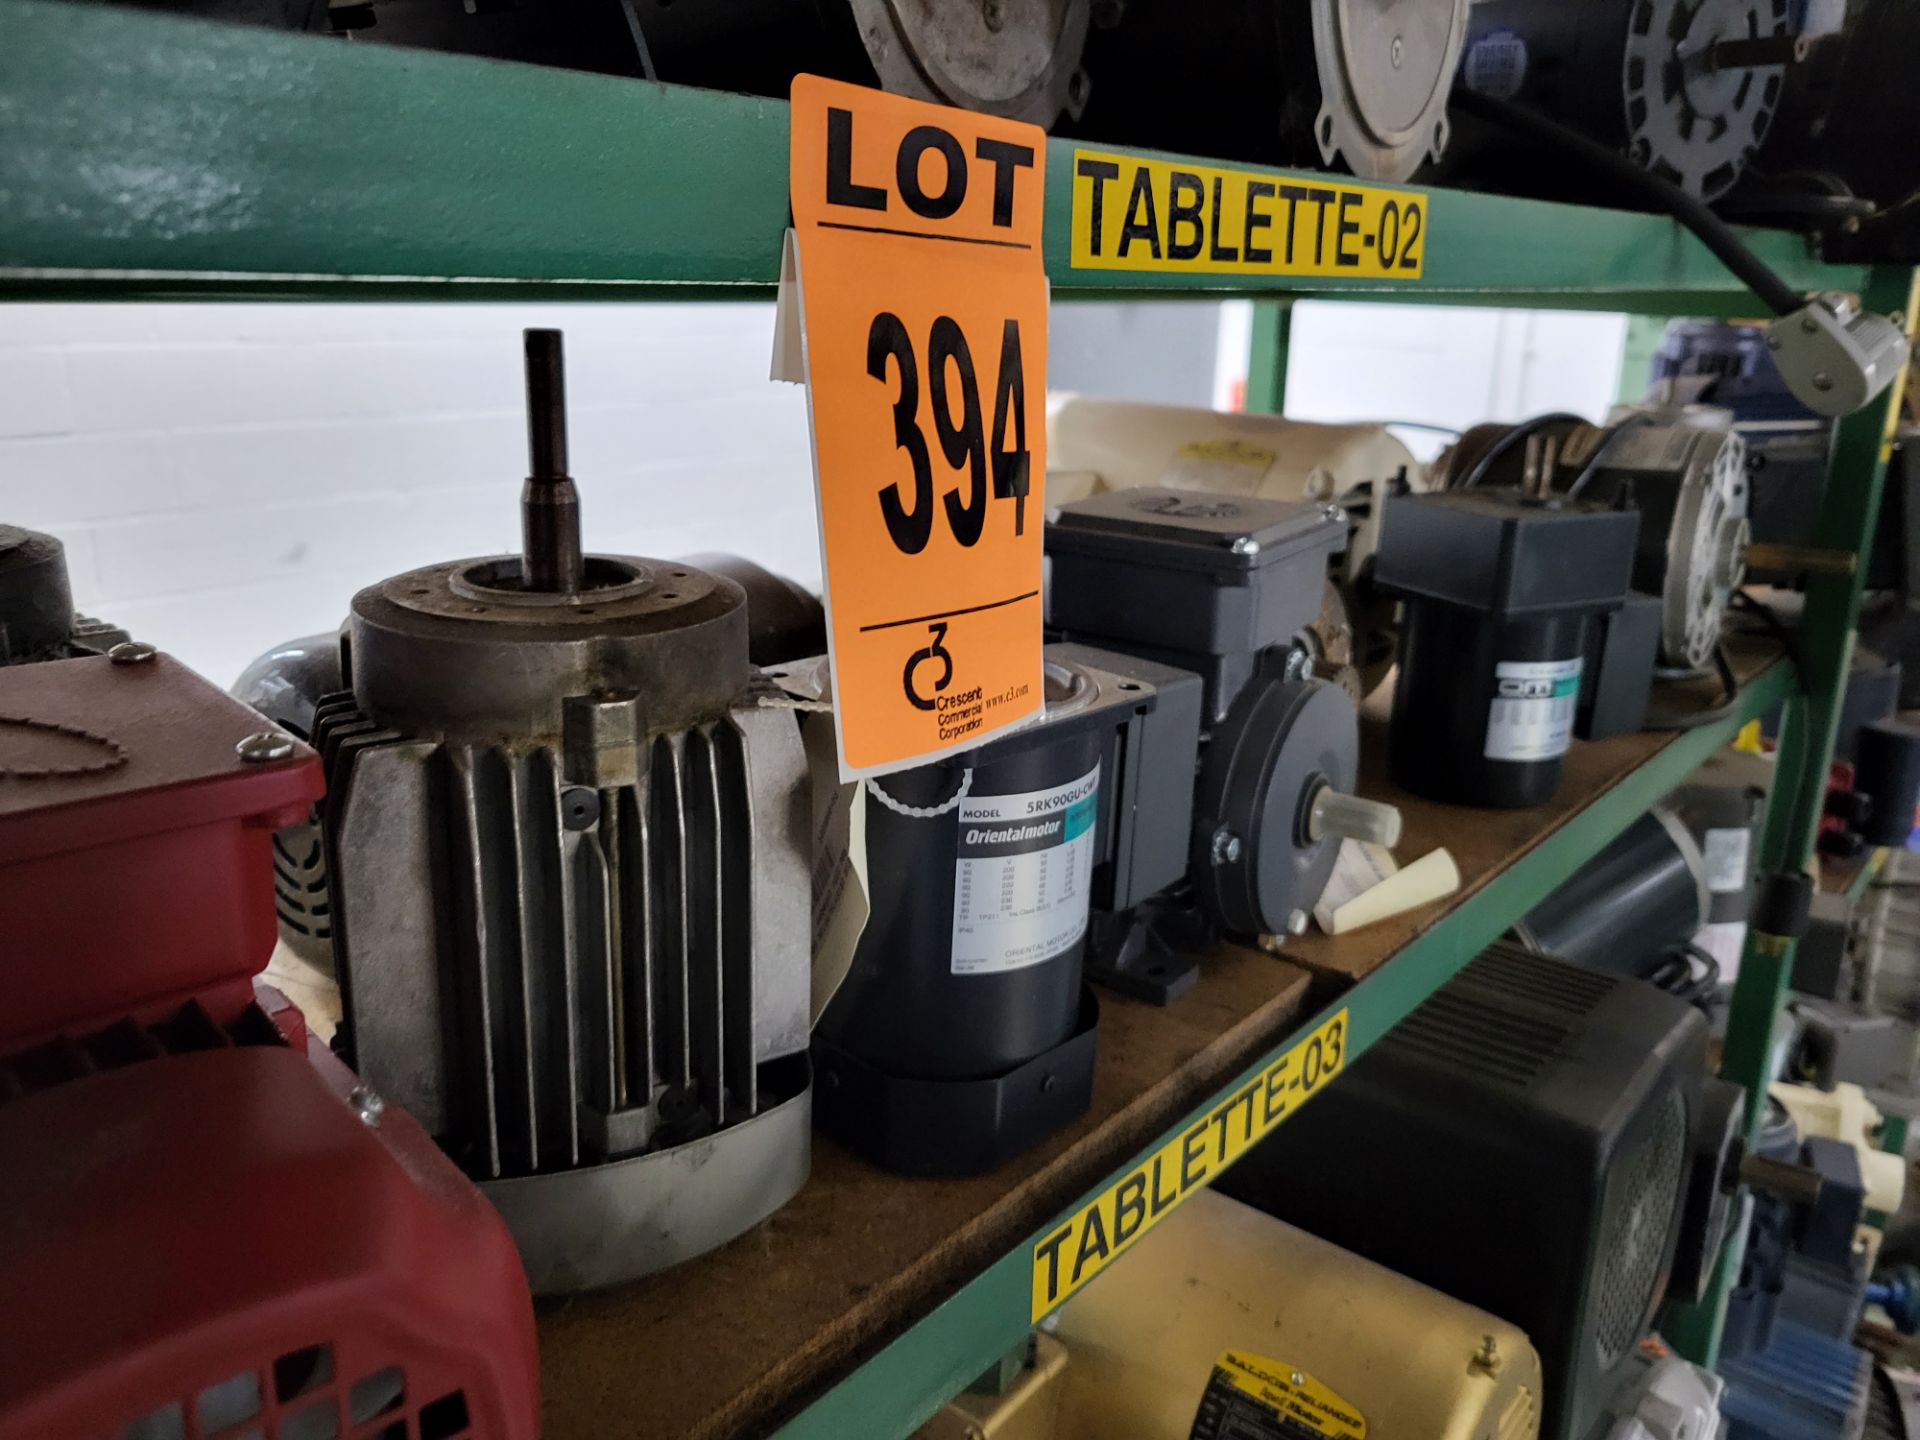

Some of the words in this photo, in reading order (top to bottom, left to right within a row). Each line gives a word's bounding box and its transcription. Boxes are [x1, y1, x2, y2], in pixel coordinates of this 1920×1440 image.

[826, 107, 1034, 228] LOT
[1077, 160, 1421, 270] TABLETTE-02
[866, 312, 1031, 554] 394
[936, 686, 983, 711] Crescent
[986, 684, 1029, 710] www.c3.com
[938, 703, 983, 727] Commercial
[939, 718, 983, 741] Corporation
[963, 809, 1001, 818] MODEL
[965, 820, 1061, 845] Orientalmotor
[1036, 1019, 1343, 1303] TABLETTE-03
